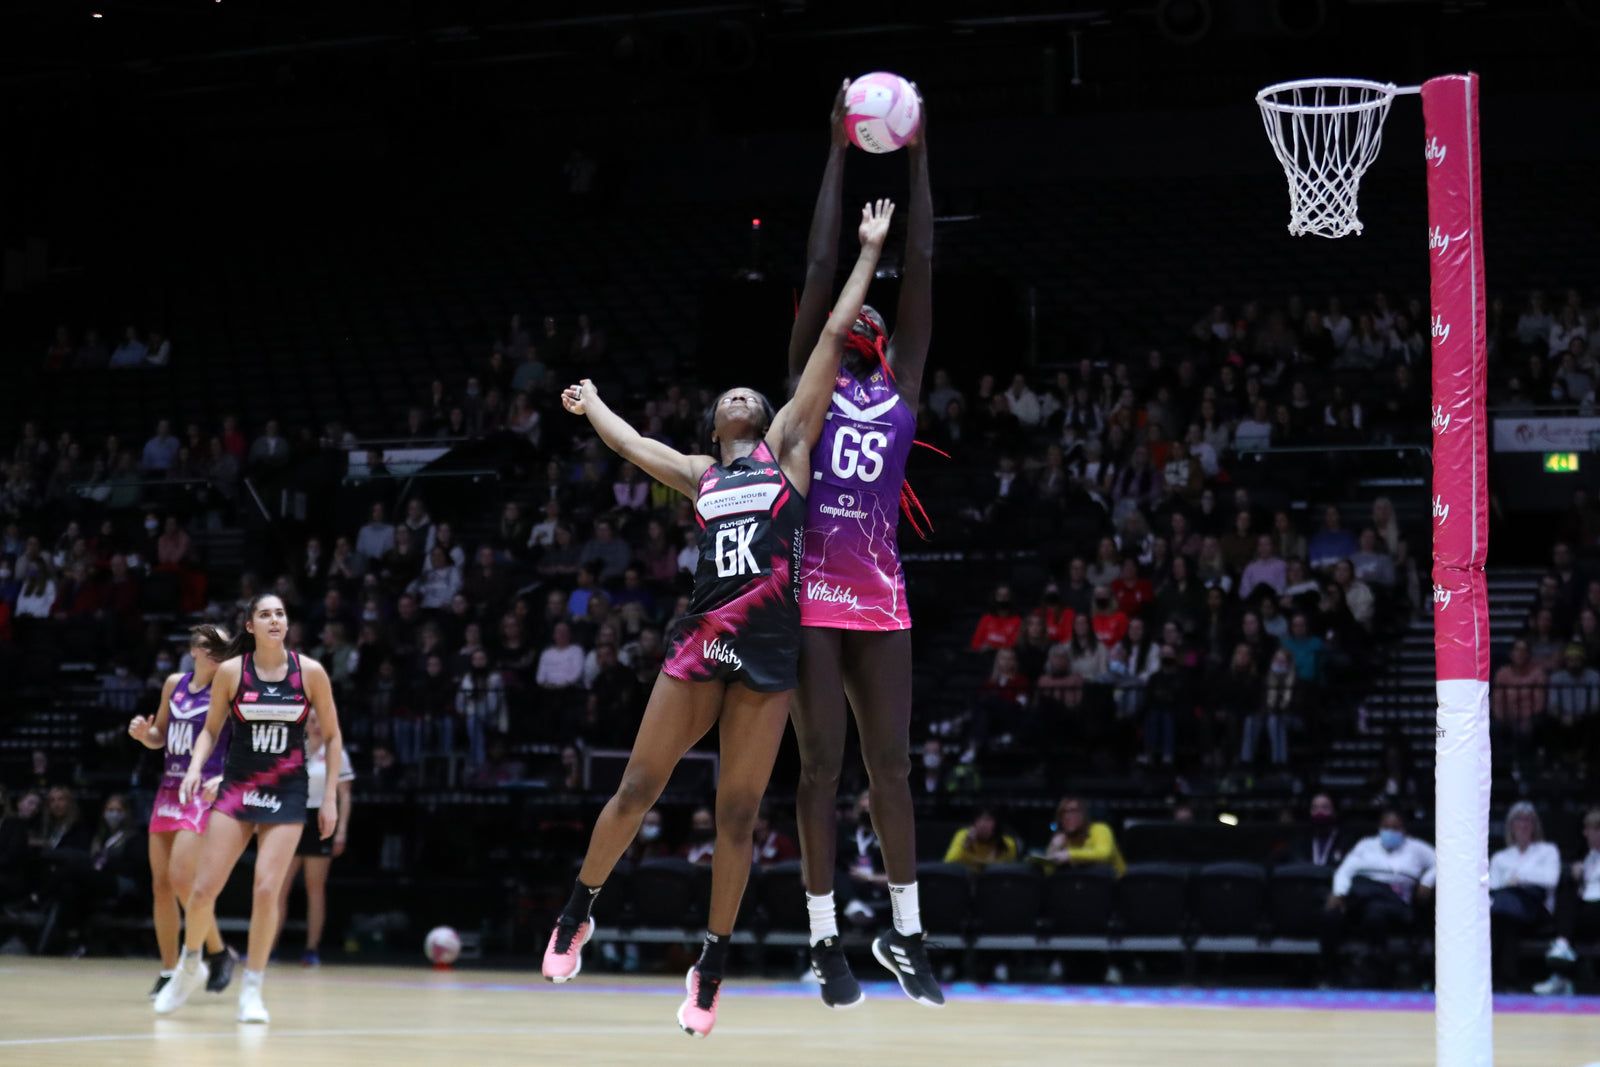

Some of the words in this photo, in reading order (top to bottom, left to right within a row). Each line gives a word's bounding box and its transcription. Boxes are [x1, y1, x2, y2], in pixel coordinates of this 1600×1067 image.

[831, 425, 887, 483] GS
[704, 496, 736, 507] ATLANTIC
[741, 492, 768, 500] HOUSE
[819, 503, 868, 520] Computacenter
[714, 522, 761, 578] GK
[807, 581, 858, 610] Vitality
[167, 723, 194, 756] WA
[252, 723, 288, 755] WD
